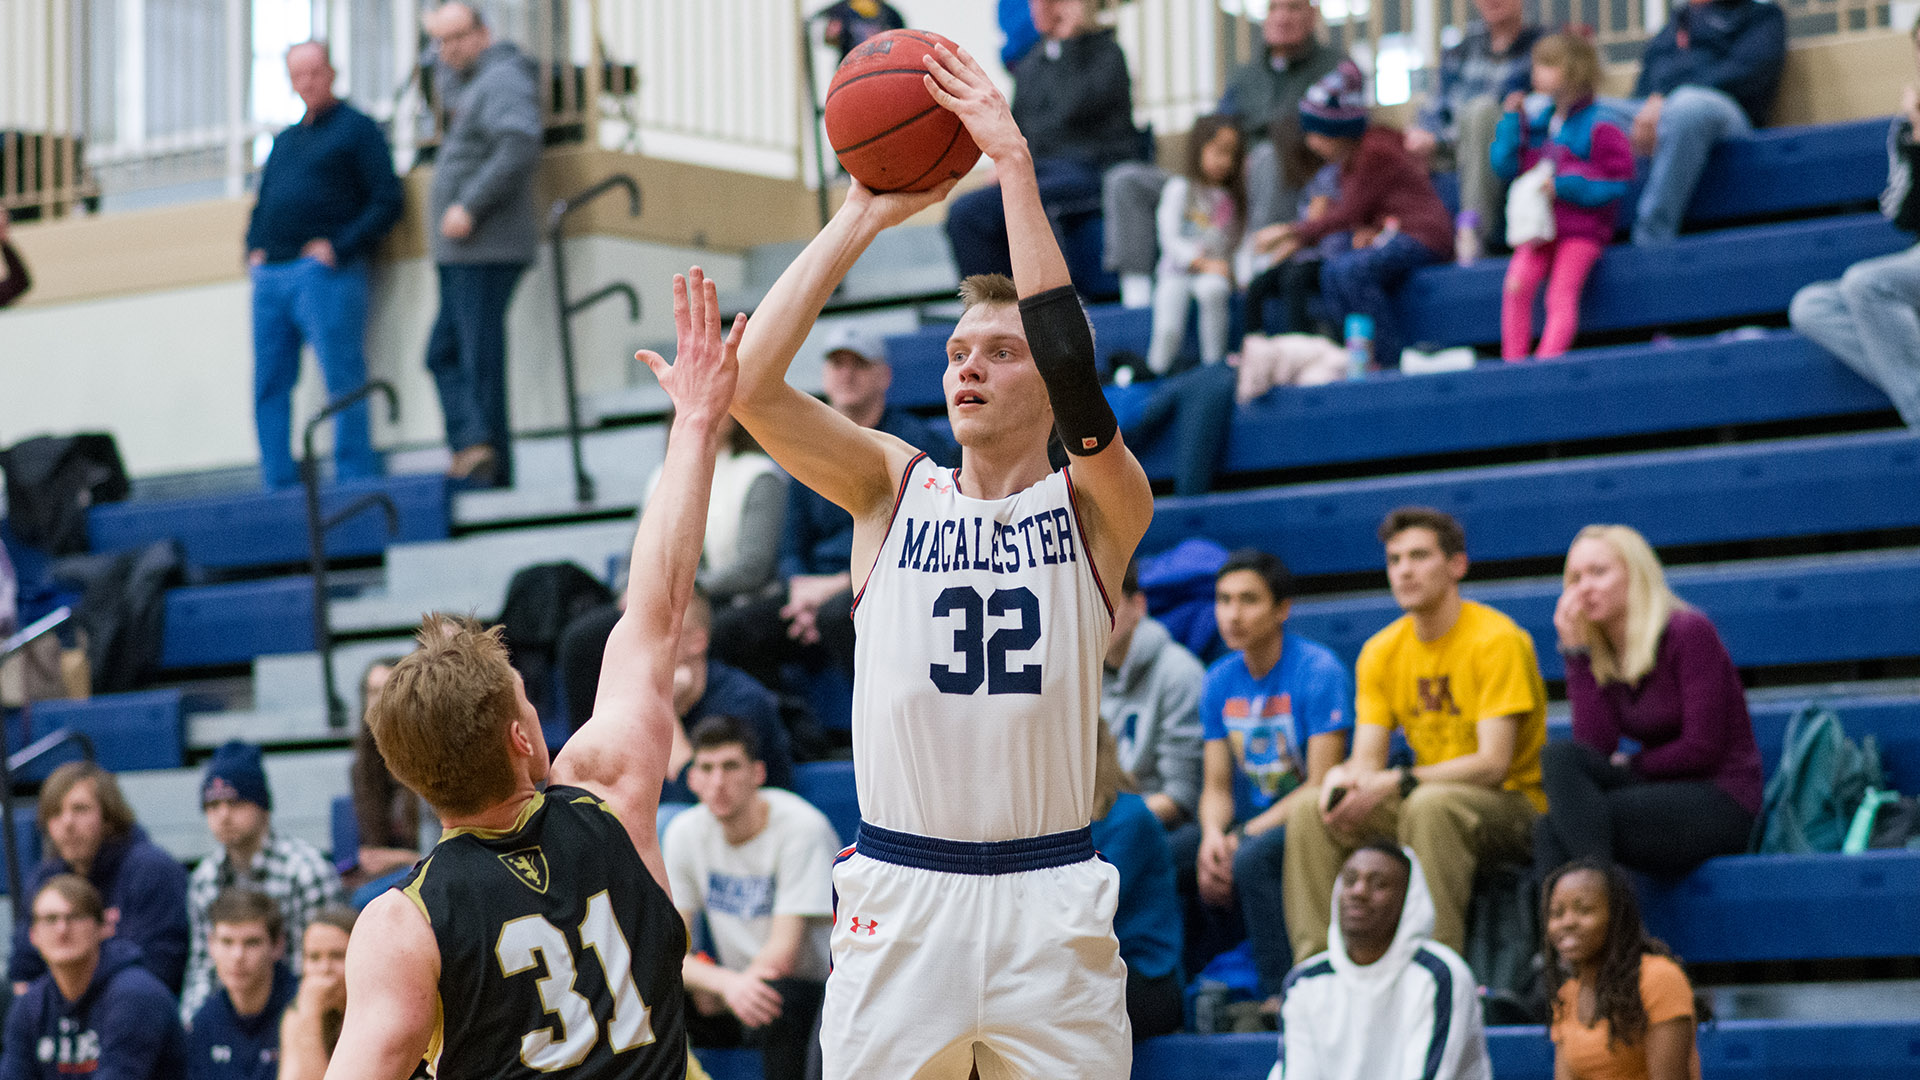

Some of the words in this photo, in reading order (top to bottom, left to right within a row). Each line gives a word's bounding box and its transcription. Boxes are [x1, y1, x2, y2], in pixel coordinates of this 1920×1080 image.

[898, 507, 1076, 574] MACALESTER
[929, 585, 1042, 695] 32
[494, 888, 656, 1073] 31
